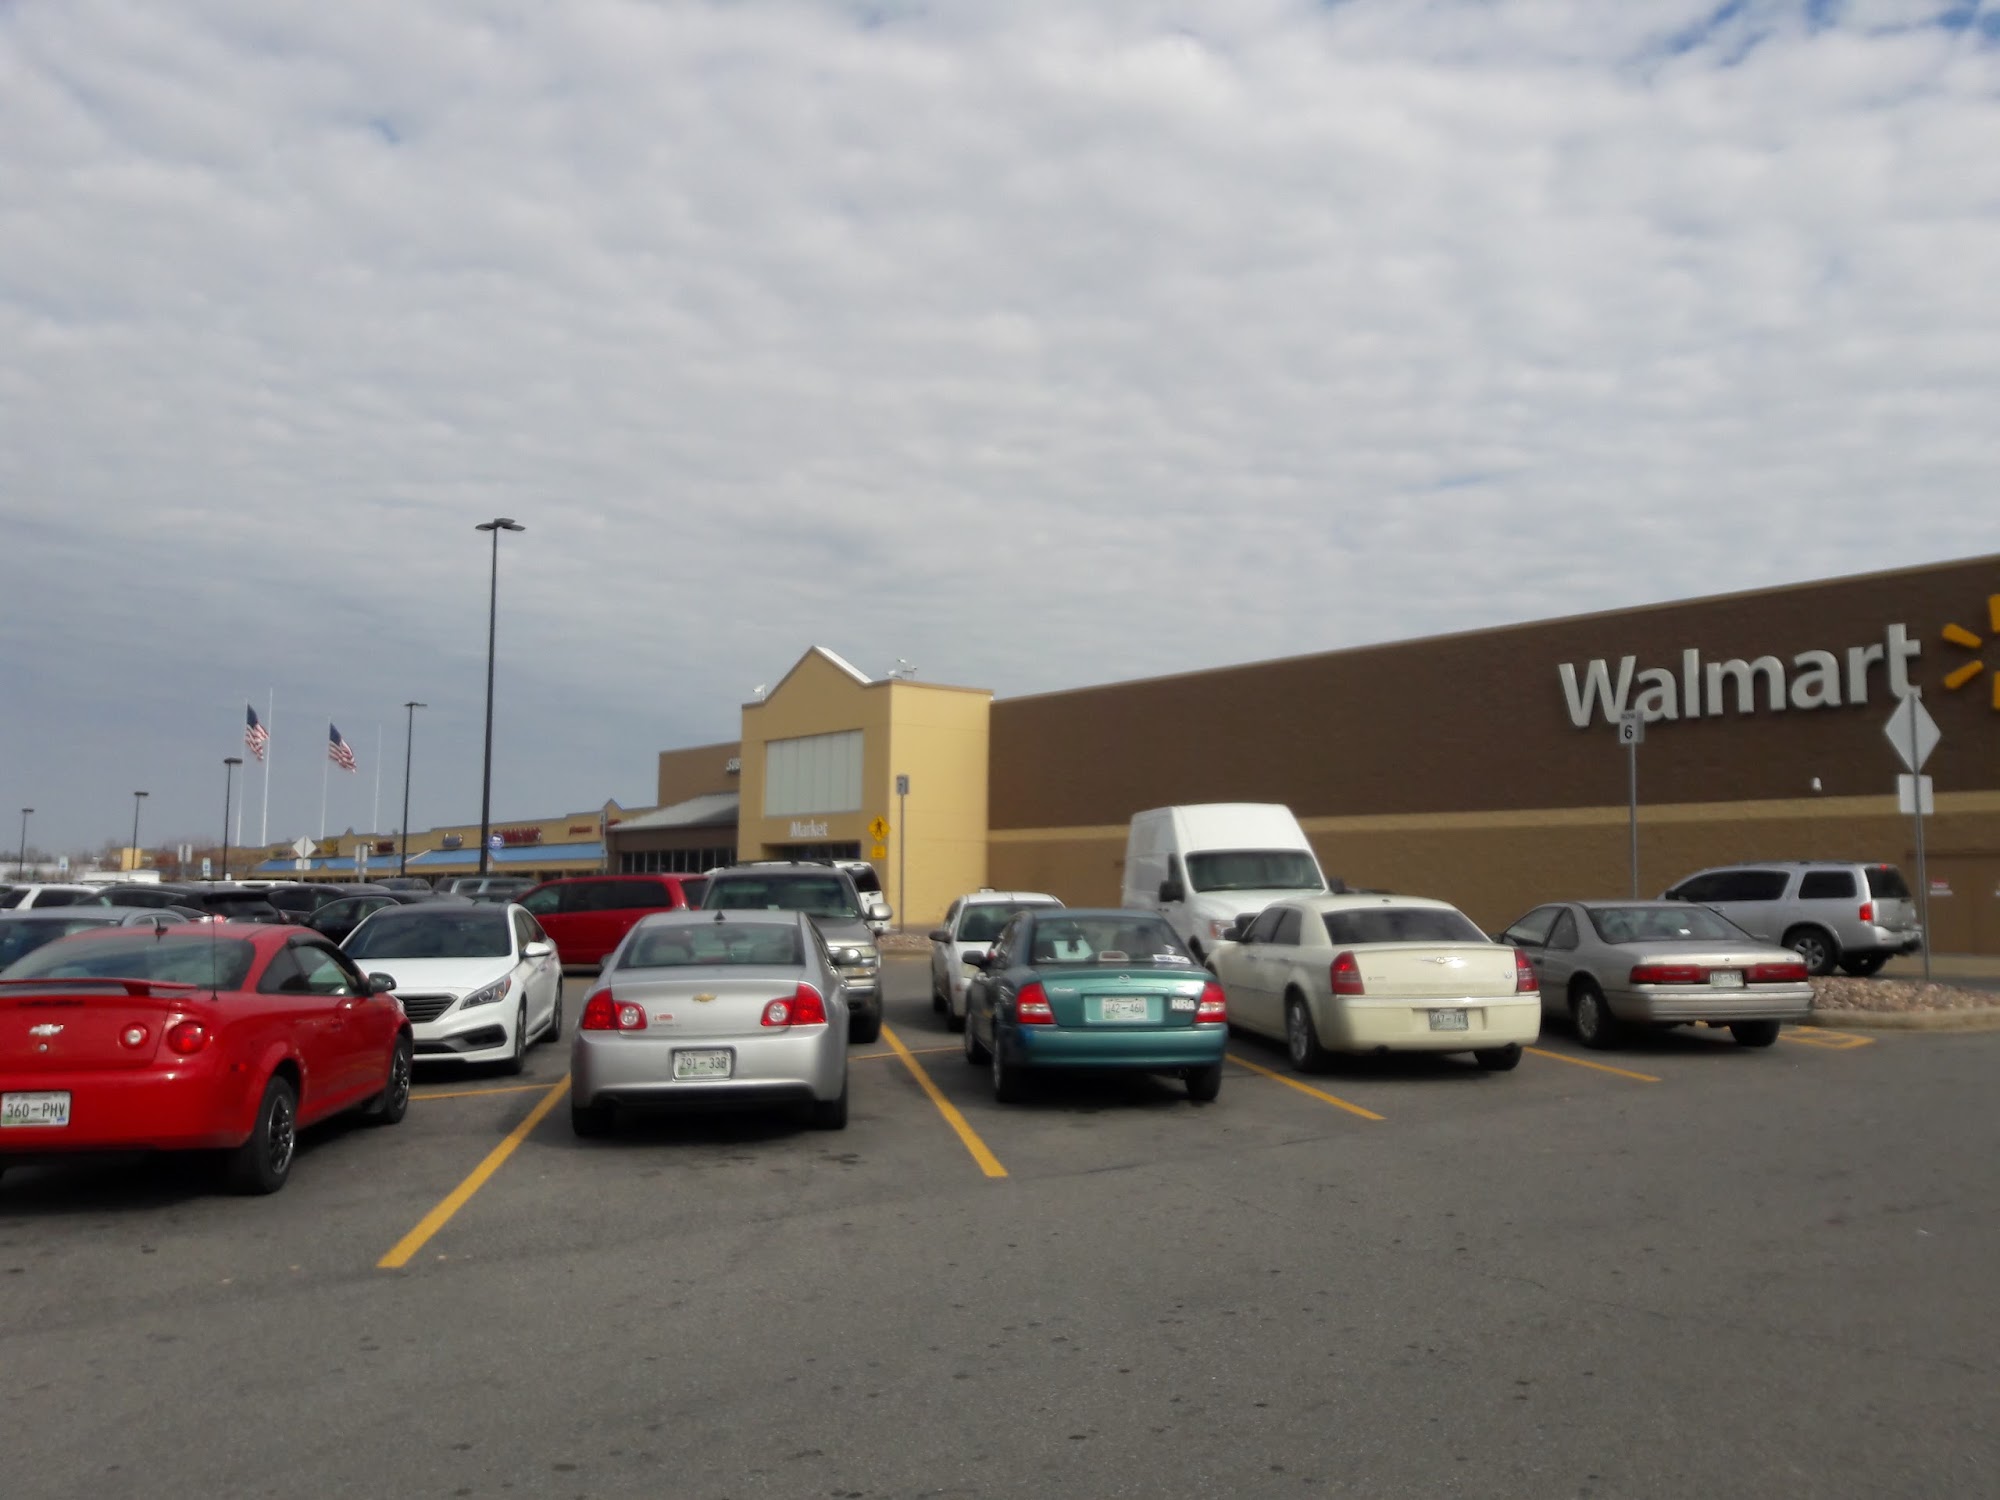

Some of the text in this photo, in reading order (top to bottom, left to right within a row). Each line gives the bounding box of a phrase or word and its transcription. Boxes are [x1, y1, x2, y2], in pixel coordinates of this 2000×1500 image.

[1558, 623, 1922, 727] Walmart
[1624, 724, 1633, 739] 6
[789, 819, 828, 837] Market
[1171, 999, 1196, 1010] NRA
[7, 1102, 66, 1118] 360-PHV
